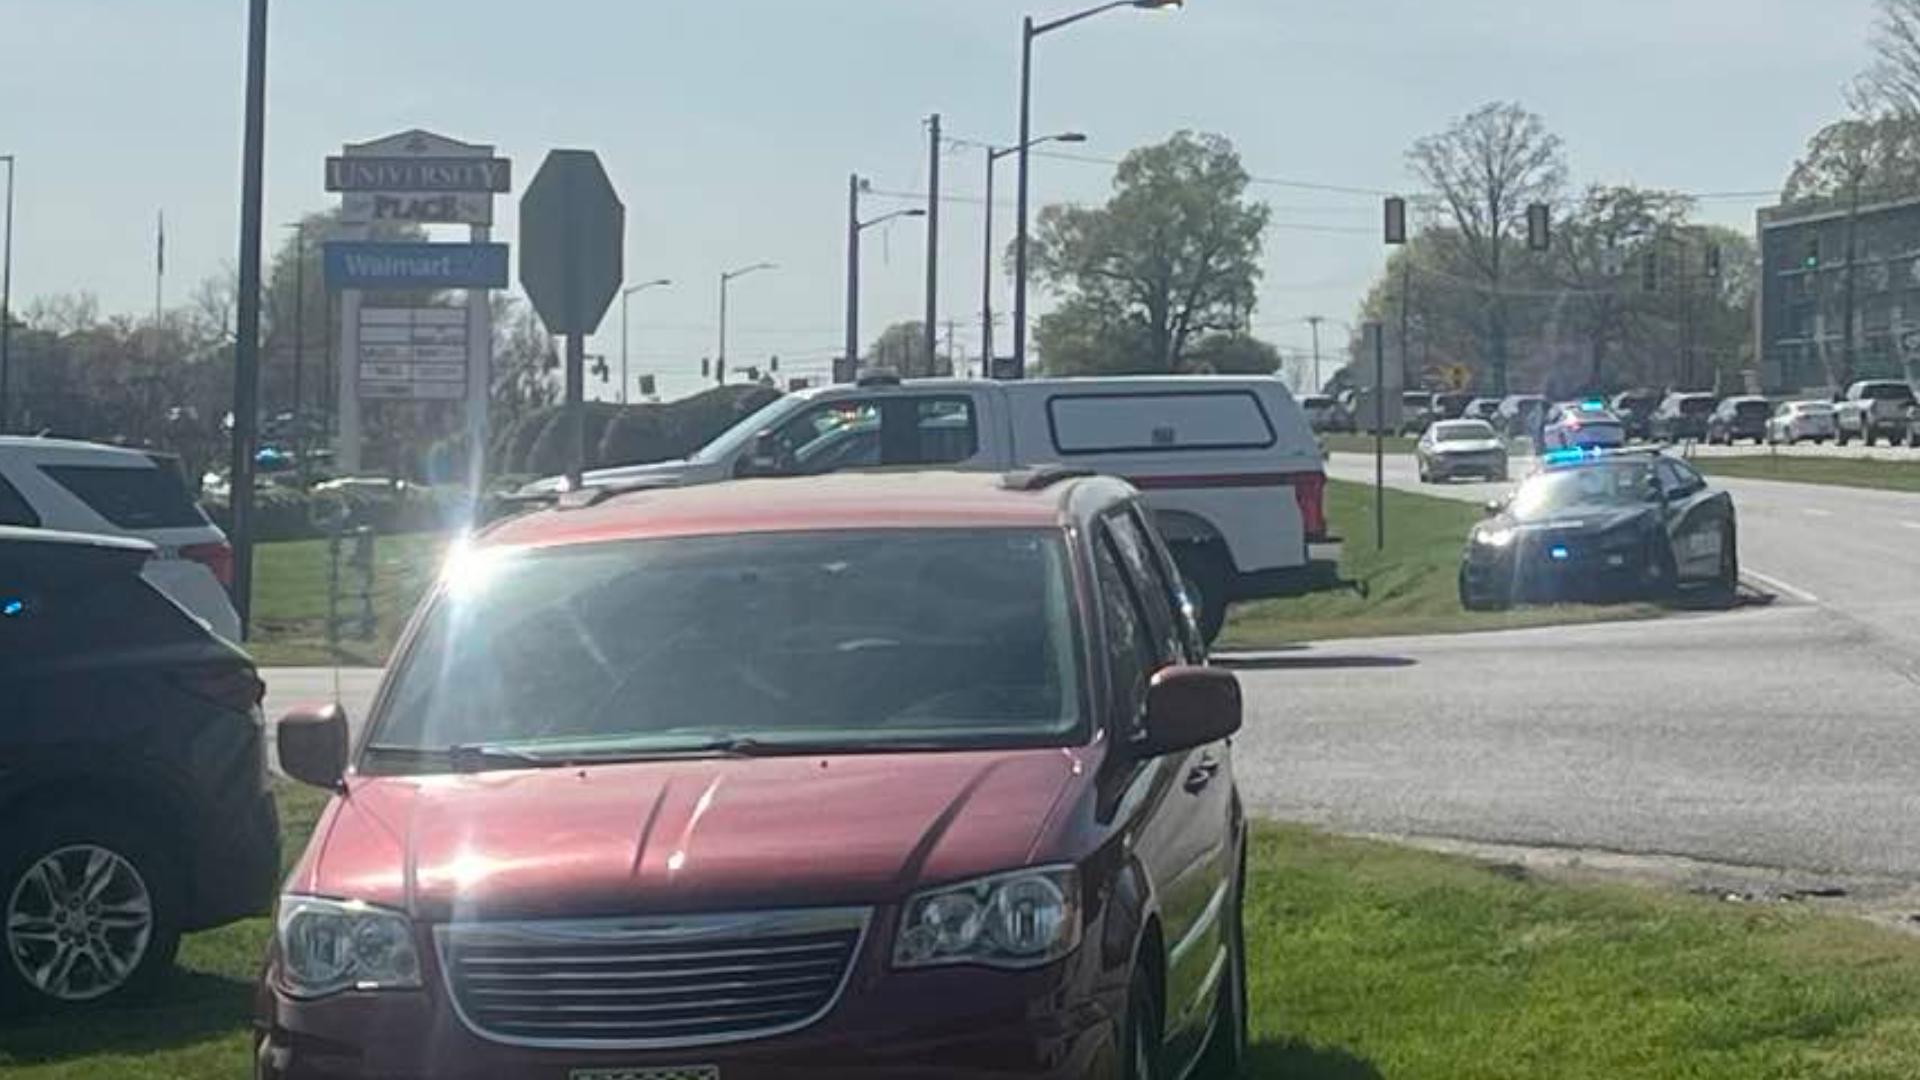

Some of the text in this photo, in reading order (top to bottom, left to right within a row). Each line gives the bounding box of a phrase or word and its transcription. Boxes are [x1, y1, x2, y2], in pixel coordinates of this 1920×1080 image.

[331, 161, 499, 188] UNIVERSITY
[374, 197, 458, 219] PLACE
[345, 254, 451, 277] Walmart
